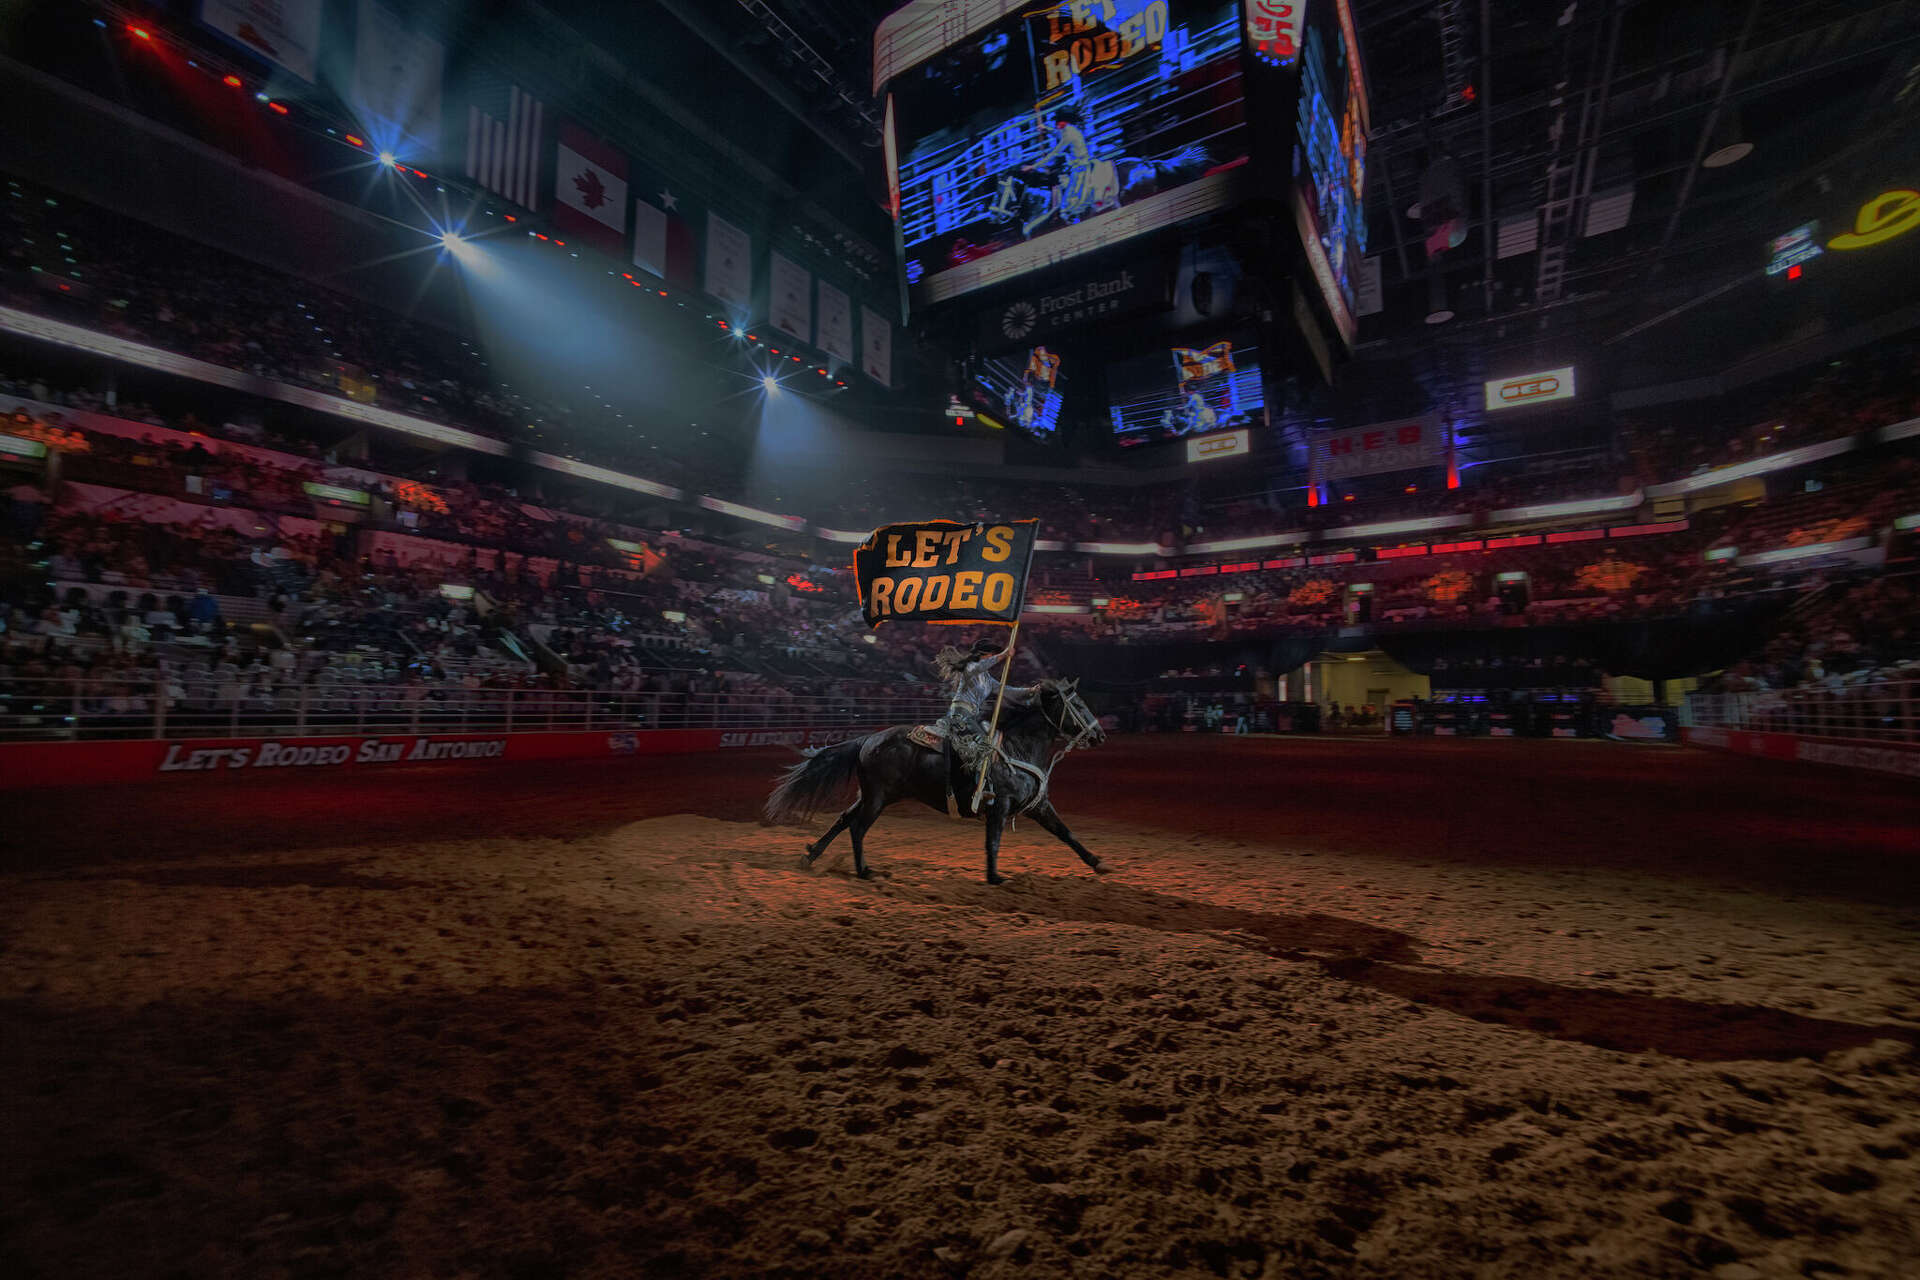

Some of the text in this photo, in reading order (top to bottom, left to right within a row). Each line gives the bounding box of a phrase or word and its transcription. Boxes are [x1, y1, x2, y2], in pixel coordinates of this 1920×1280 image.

[1043, 0, 1167, 90] RODEO
[1040, 271, 1135, 315] Frost Bank
[1051, 300, 1120, 326] CENTER
[885, 522, 1015, 568] LET'S
[870, 570, 1015, 619] RODEO
[160, 738, 506, 772] LET'S RODEO SAN ANTONIO!
